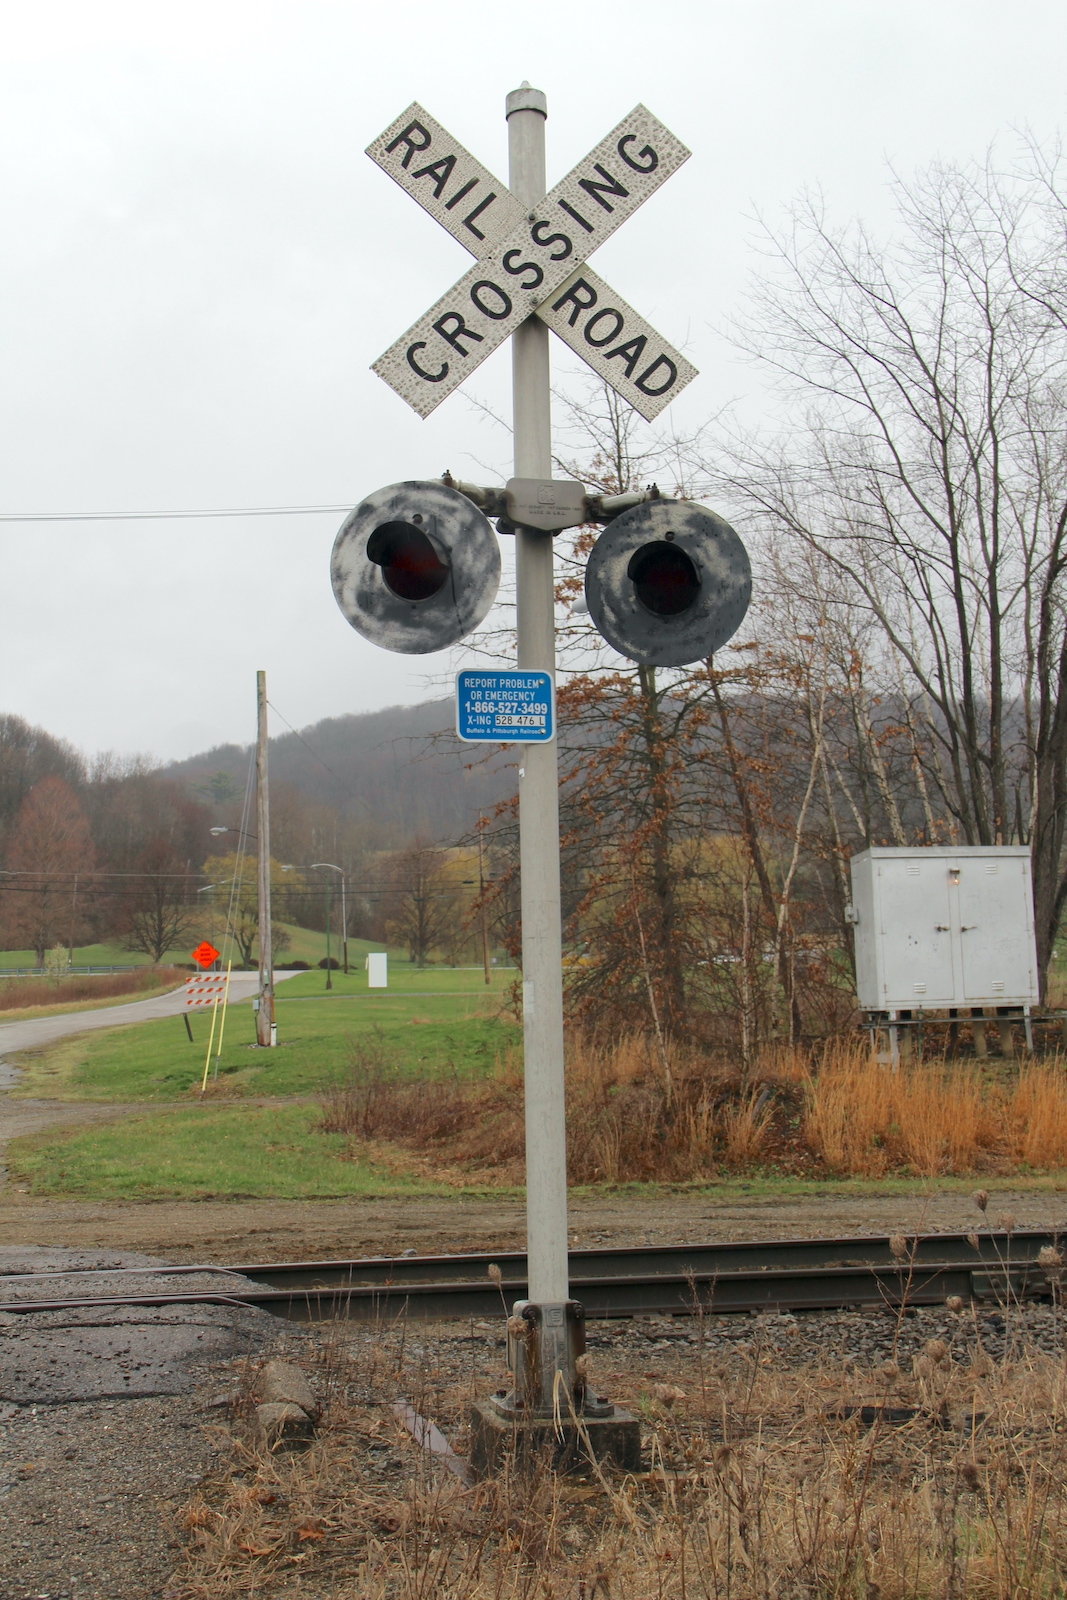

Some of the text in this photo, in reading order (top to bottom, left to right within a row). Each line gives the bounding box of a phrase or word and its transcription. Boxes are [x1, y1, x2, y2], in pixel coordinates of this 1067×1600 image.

[384, 118, 678, 397] RAIL ROAD
[405, 133, 660, 383] CROSSING
[464, 678, 539, 689] REPORT PROBLEM
[470, 691, 536, 701] OR EMERGENCY
[464, 701, 548, 714] 1-866-527-3499
[467, 715, 545, 725] X-ING 528 476 L
